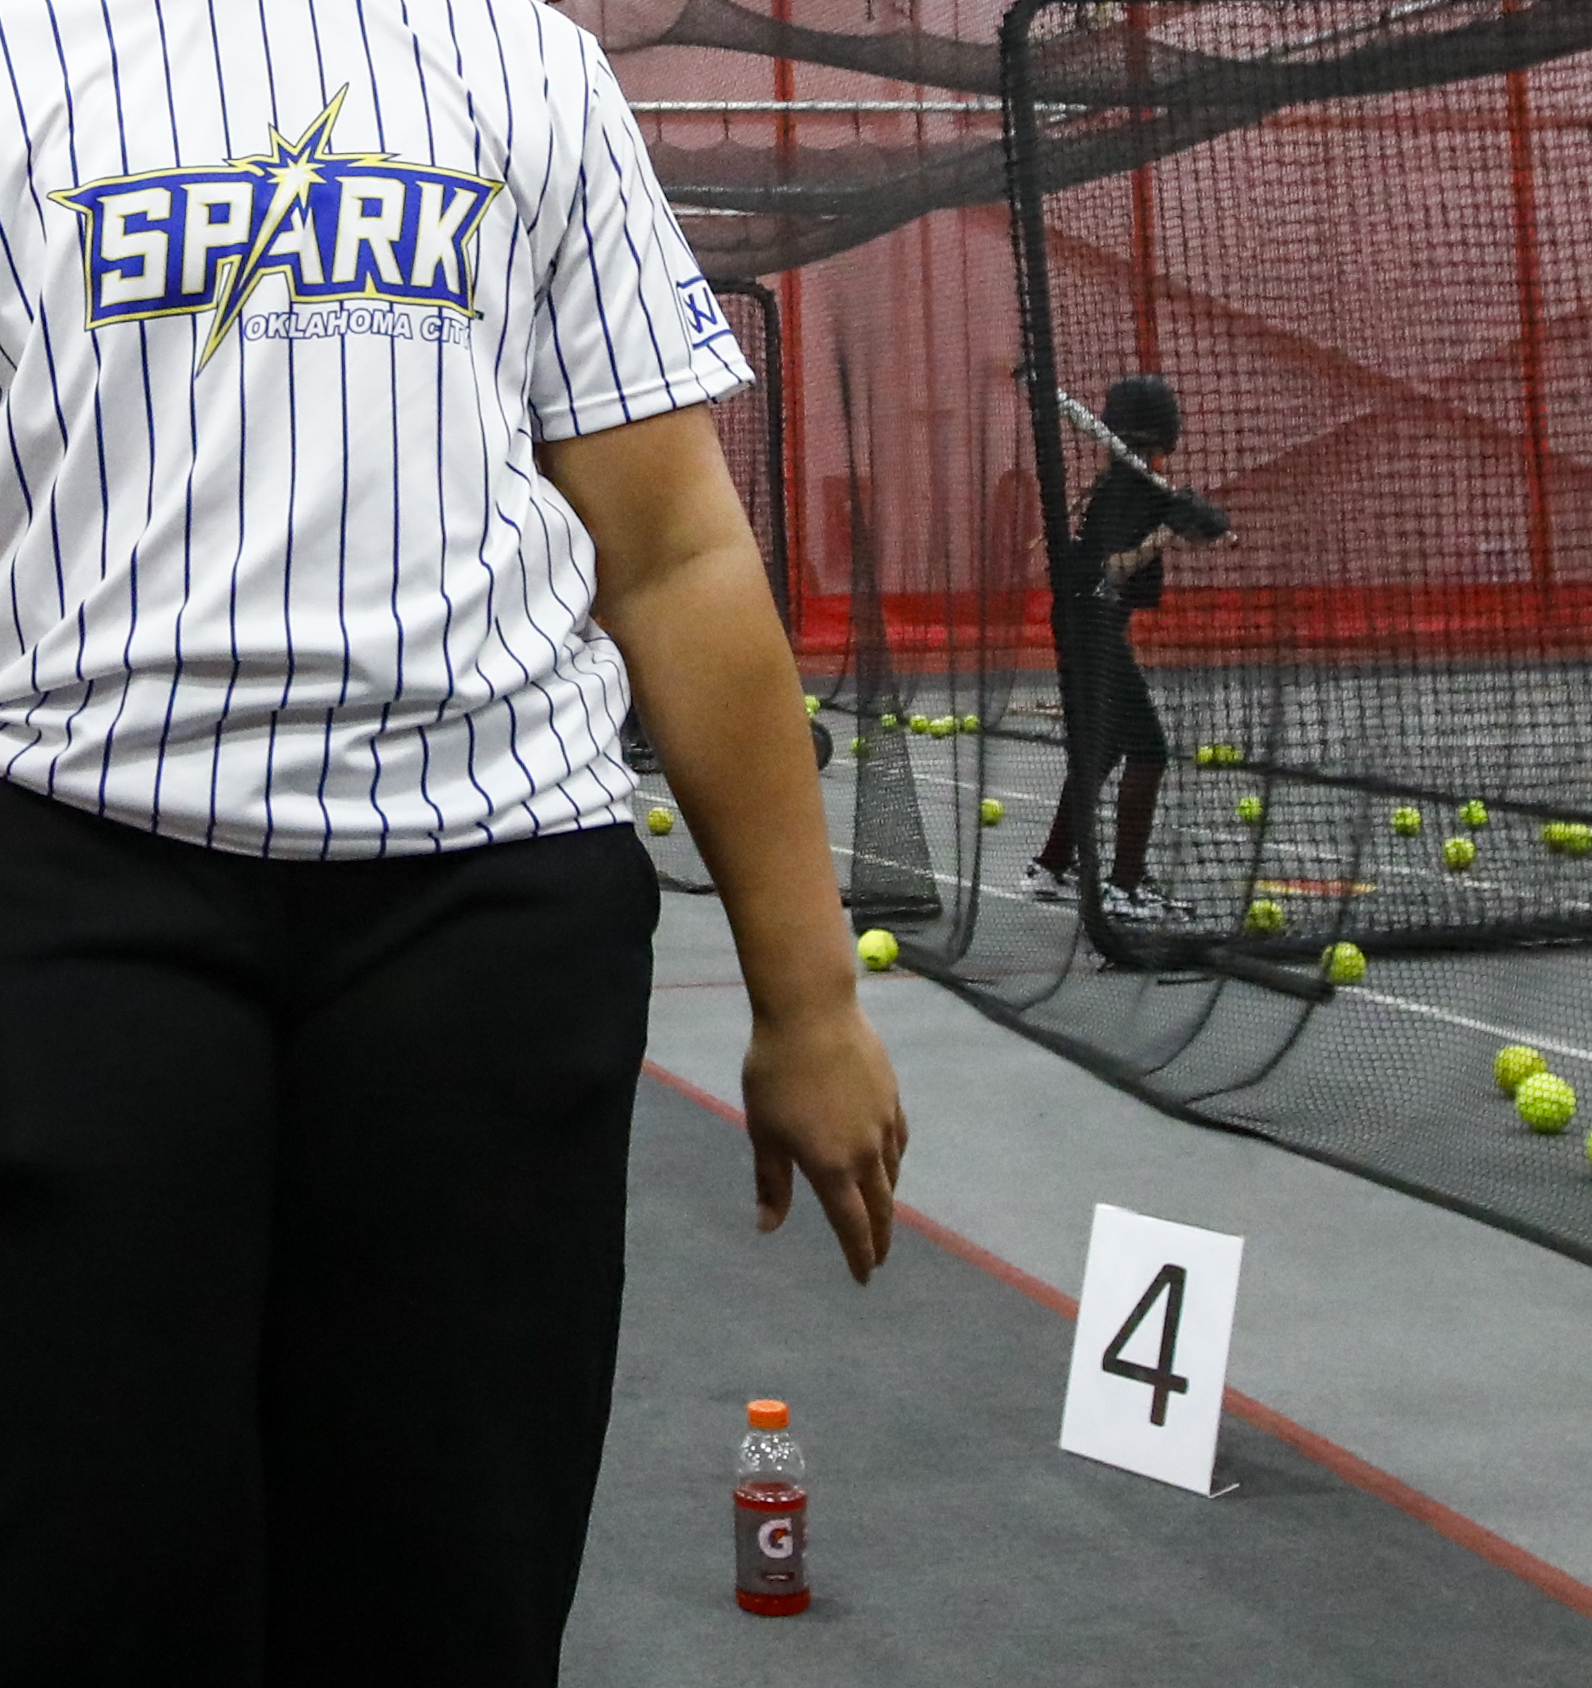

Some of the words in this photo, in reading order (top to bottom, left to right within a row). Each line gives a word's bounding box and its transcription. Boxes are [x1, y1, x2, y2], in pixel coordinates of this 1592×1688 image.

[97, 168, 478, 308] SPARK
[244, 307, 413, 342] OKLAHOMA
[1101, 1263, 1189, 1427] 4
[758, 1517, 794, 1560] G
